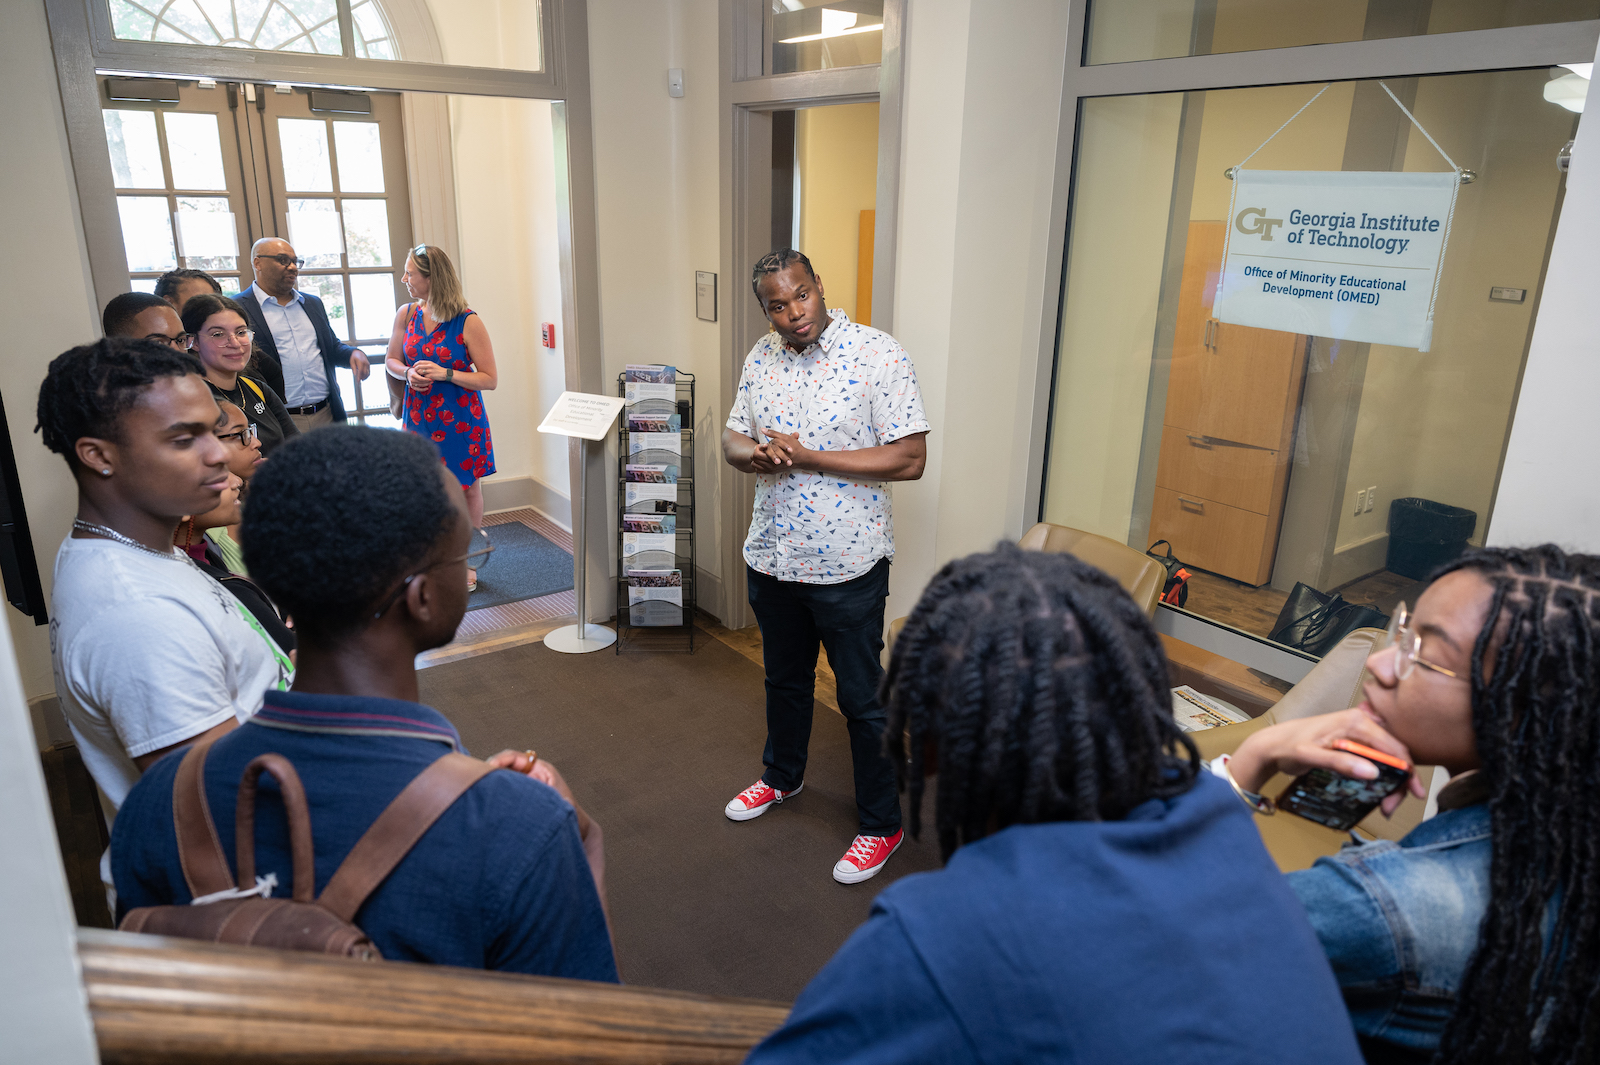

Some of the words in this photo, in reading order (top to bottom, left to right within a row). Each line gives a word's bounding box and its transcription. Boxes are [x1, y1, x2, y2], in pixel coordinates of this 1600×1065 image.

[1235, 207, 1283, 241] GT
[1289, 209, 1356, 232] Georgia
[1359, 212, 1440, 233] Institute
[1287, 228, 1305, 244] of
[1244, 265, 1274, 279] Office
[1276, 269, 1288, 280] of
[1289, 270, 1337, 287] Minority
[1339, 275, 1407, 291] Educational
[1262, 282, 1334, 300] Development
[1336, 288, 1381, 306] (OMED)
